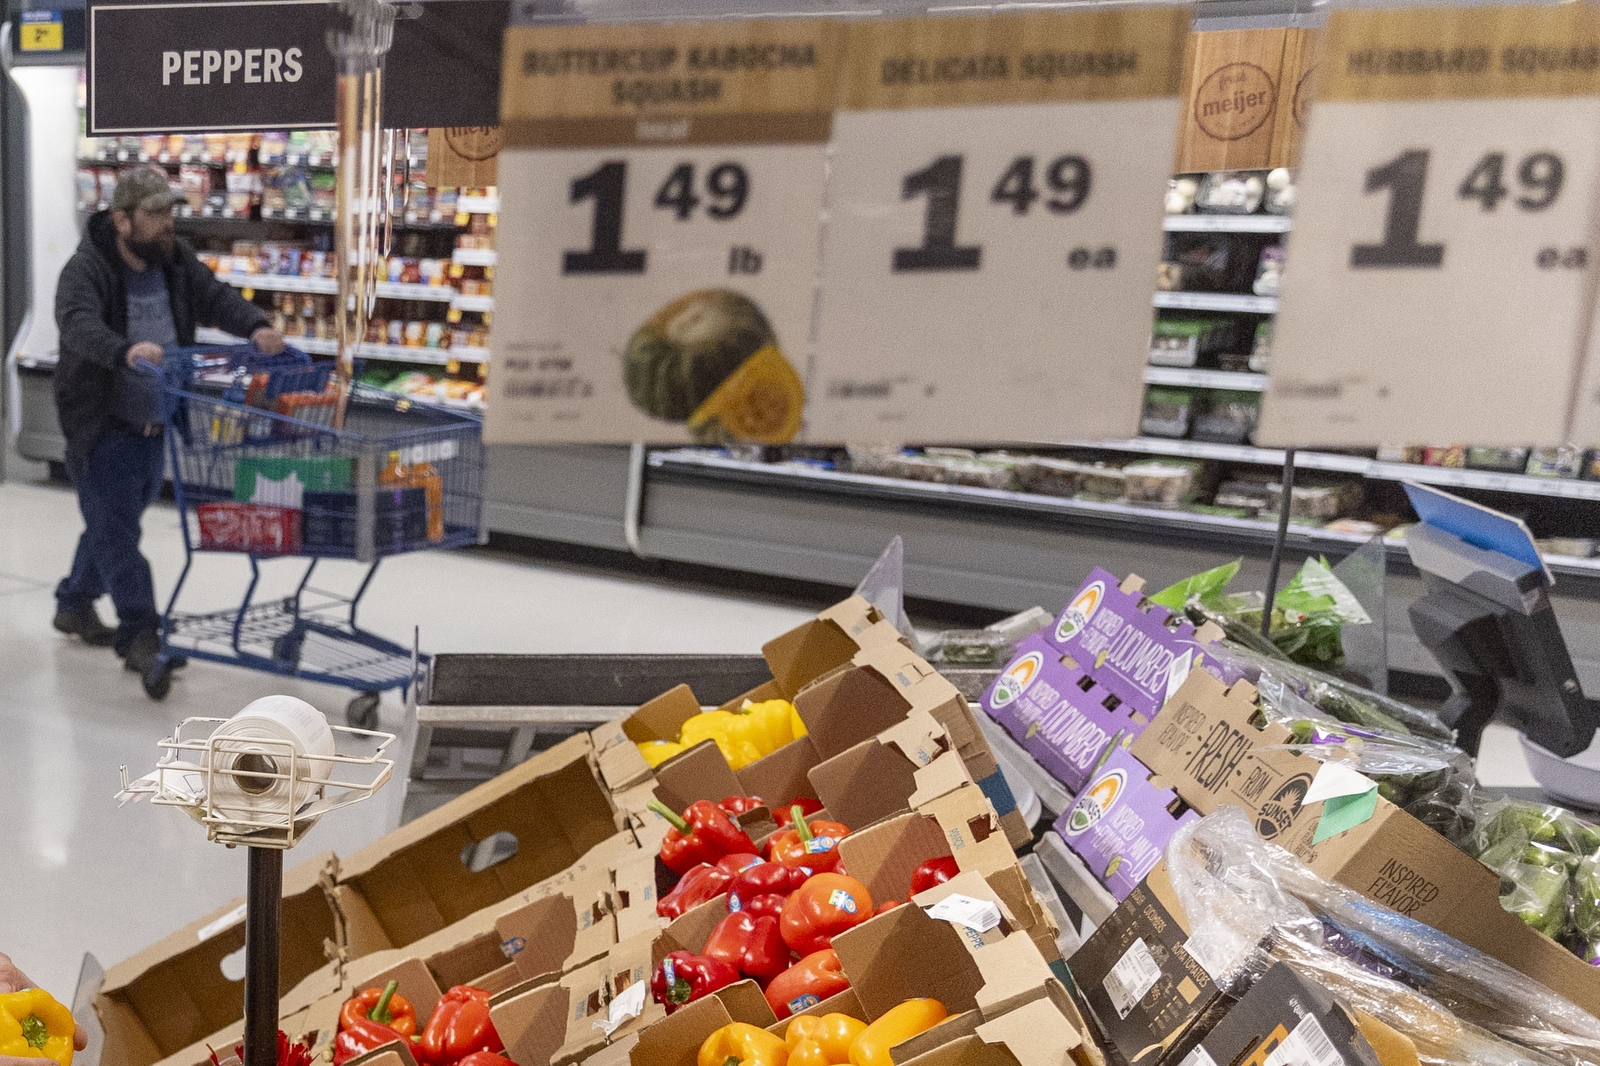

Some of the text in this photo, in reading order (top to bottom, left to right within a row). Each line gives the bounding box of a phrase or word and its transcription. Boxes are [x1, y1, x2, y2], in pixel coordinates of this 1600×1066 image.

[161, 47, 304, 87] PEPPERS
[522, 43, 815, 77] BUTTERCUP KABOCHA
[881, 50, 1139, 86] DELICATA SQUASH
[1347, 46, 1490, 77] HUBBARD
[611, 77, 722, 106] SQUASH
[1201, 89, 1268, 118] meijer
[727, 247, 763, 276] lb
[1066, 246, 1117, 271] ea
[1535, 246, 1587, 270] ea
[1106, 624, 1175, 694] CUCUMBERS
[1039, 700, 1112, 769] CUCUMBERS
[1172, 702, 1207, 735] INSPIRED
[1184, 719, 1254, 795] FRESH
[1239, 765, 1273, 803] FROM
[1258, 803, 1293, 835] SUNSET
[1367, 876, 1422, 916] FLAVOR
[1379, 857, 1440, 904] INSPIRED
[1143, 904, 1168, 934] CUCUMBERS
[1170, 940, 1211, 989] ROMA TOMATOES
